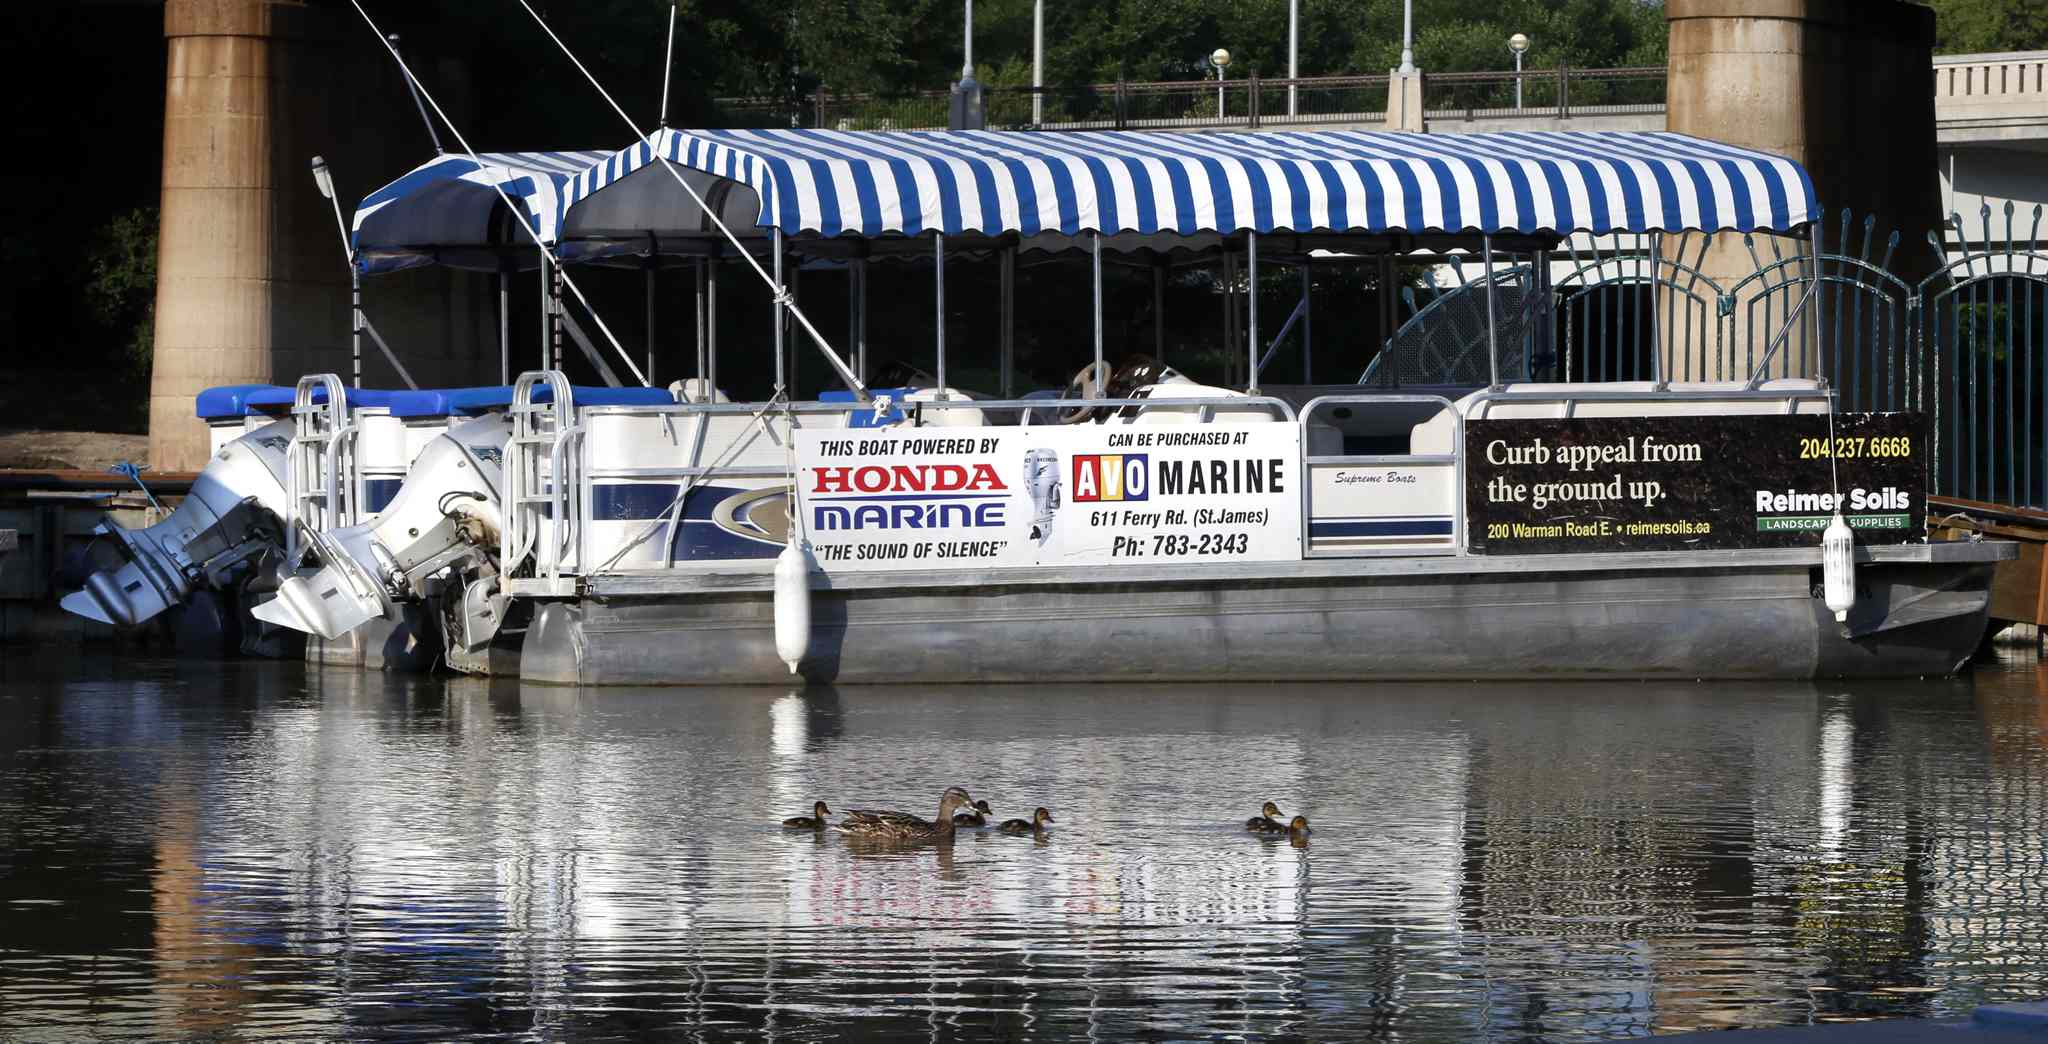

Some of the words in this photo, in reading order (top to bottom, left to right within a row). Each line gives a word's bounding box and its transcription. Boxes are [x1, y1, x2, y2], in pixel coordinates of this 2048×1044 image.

[819, 440, 854, 457] THIS
[858, 439, 898, 456] BOAT
[902, 438, 975, 455] POWERED
[980, 438, 999, 454] BY
[1108, 433, 1133, 447] CAN
[1137, 432, 1153, 446] BE
[1157, 432, 1229, 446] PURCHASED
[1233, 432, 1249, 445] AT
[1486, 438, 1550, 465] Curb
[1556, 437, 1636, 471] appeal
[1642, 436, 1702, 462] from
[812, 463, 1008, 493] HONDA
[1077, 458, 1145, 497] AVO
[1159, 459, 1284, 495] MARINE
[1335, 472, 1382, 485] Supreme
[1387, 472, 1416, 483] Boats
[1488, 477, 1527, 503] the
[1533, 474, 1623, 509] ground
[1629, 482, 1666, 507] up.
[1756, 489, 1845, 512] Reimer
[1850, 487, 1909, 510] Soils
[1091, 511, 1117, 526] 611
[1123, 510, 1161, 528] Ferry
[1165, 509, 1188, 525] Rd.
[1193, 508, 1269, 527] (St.James)
[1767, 519, 1842, 529] LANDSCAPI
[1850, 517, 1902, 528] SUPPLIES
[1488, 523, 1509, 539] 200
[1513, 522, 1562, 538] Warman
[1566, 521, 1597, 537] Road
[1600, 521, 1612, 536] E.
[857, 543, 907, 559] SOUND
[913, 542, 932, 557] OF
[1112, 536, 1144, 557] Ph:
[1153, 533, 1248, 556] 783-2343
